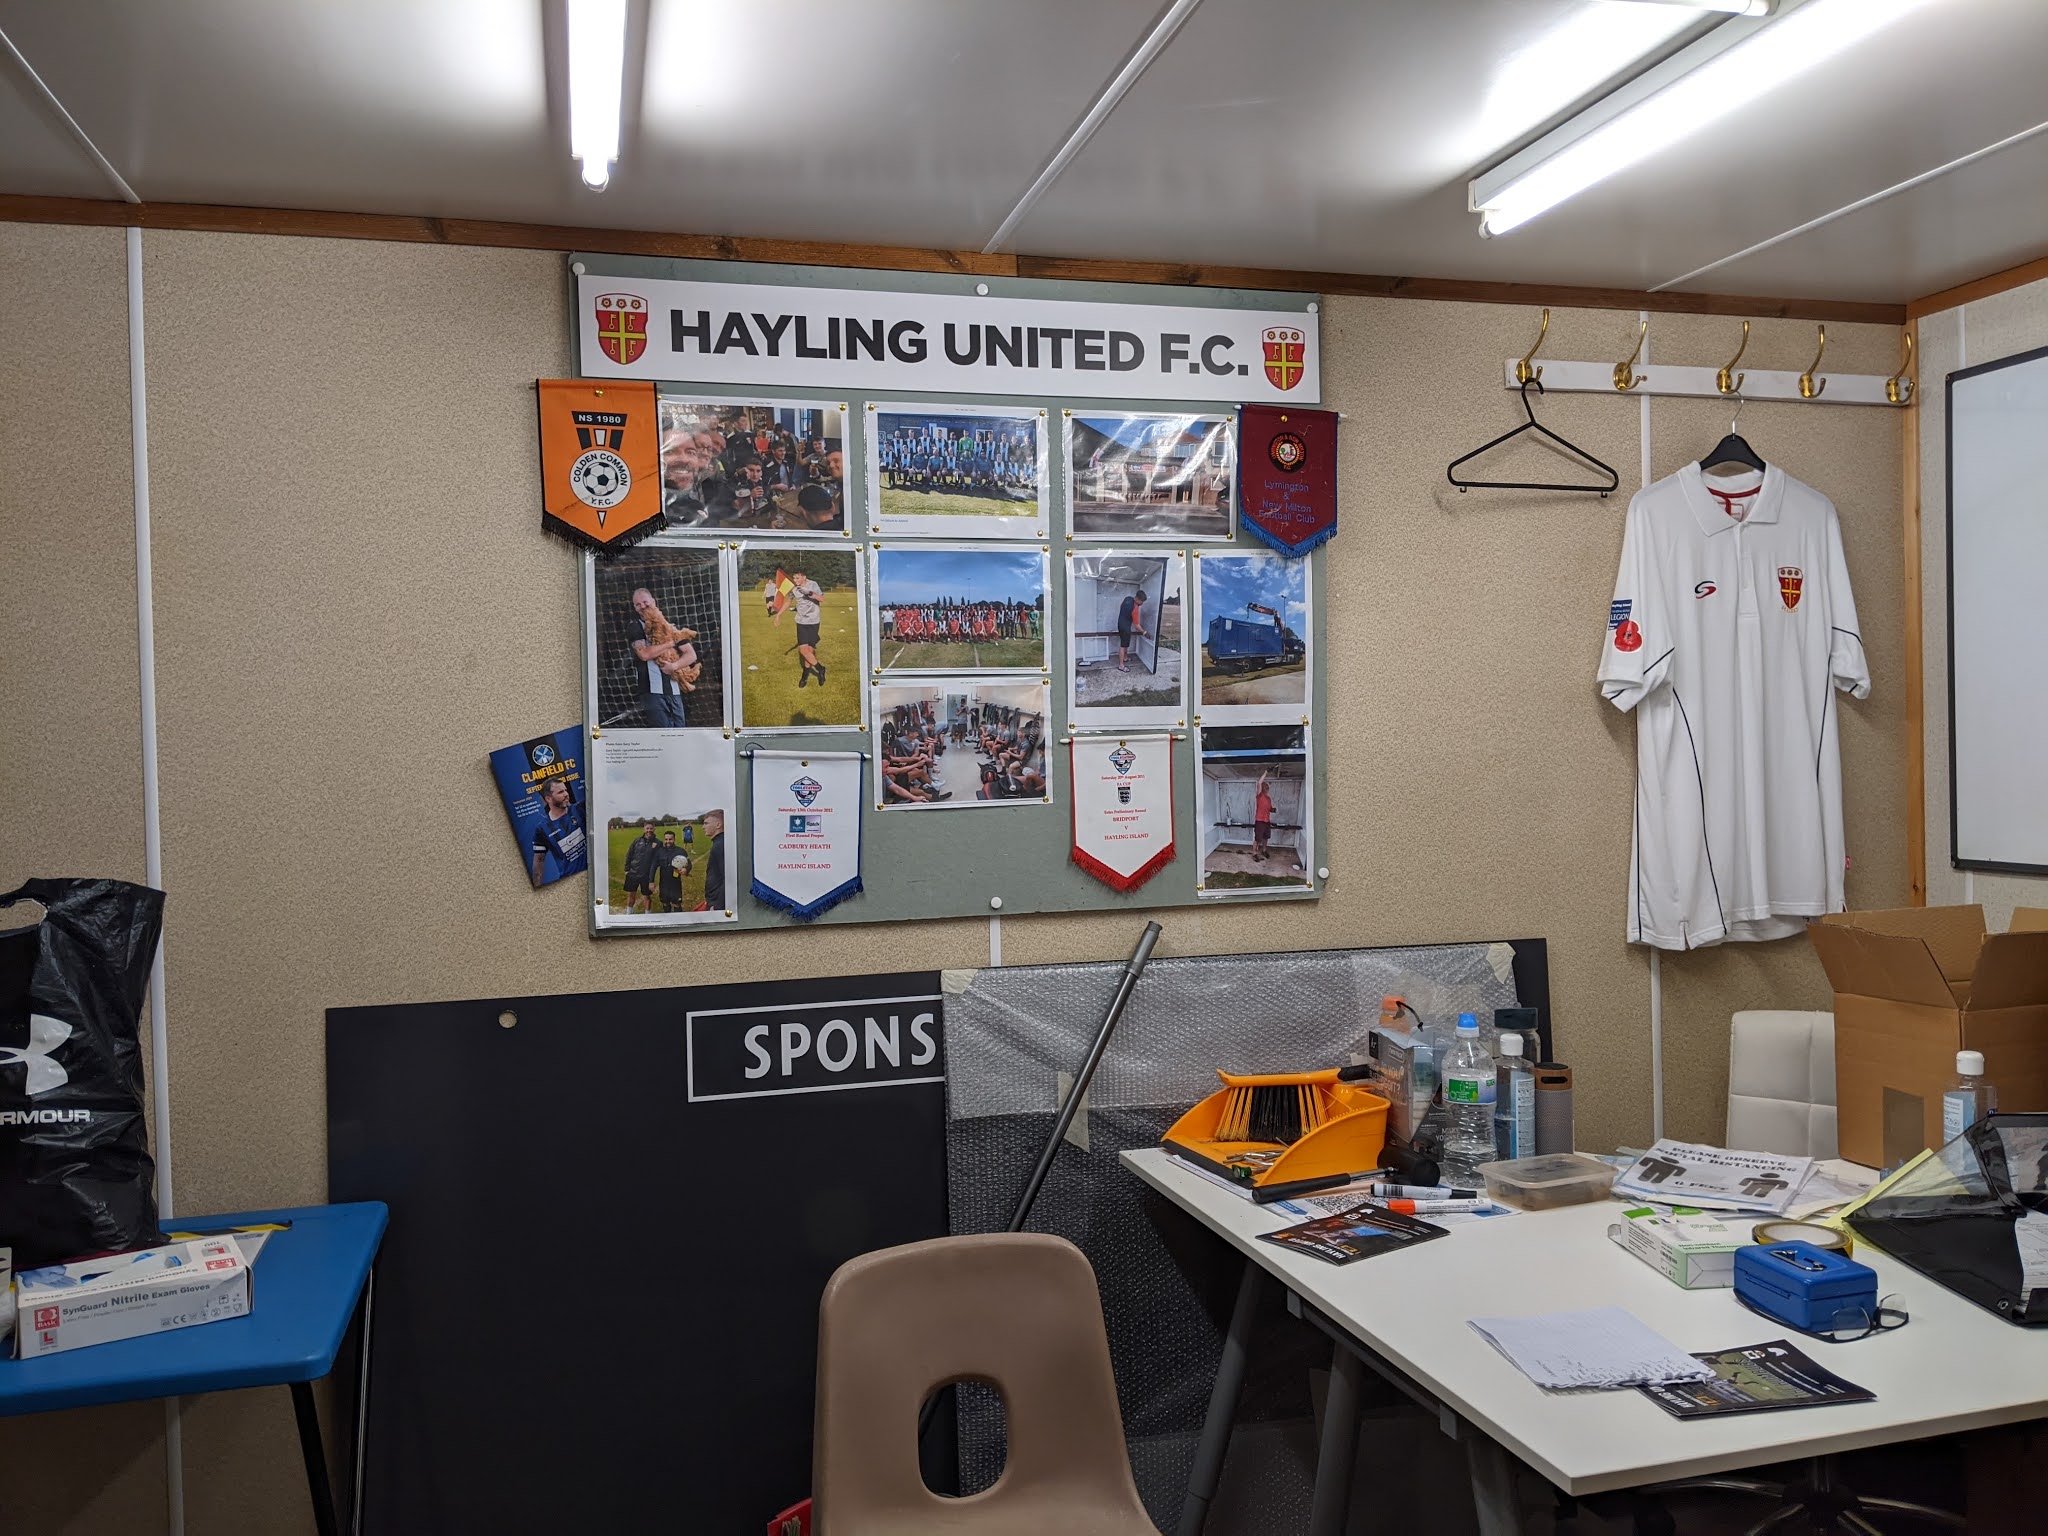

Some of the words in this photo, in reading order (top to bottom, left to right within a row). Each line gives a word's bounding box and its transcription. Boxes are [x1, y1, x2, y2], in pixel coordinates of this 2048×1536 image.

[670, 307, 928, 364] HAYLING
[944, 325, 1146, 373] UNITED
[1161, 333, 1249, 377] F.C.
[578, 414, 593, 422] NS
[597, 415, 621, 424] 1980
[573, 452, 598, 483] COLDEN
[599, 452, 628, 487] COMMON
[1264, 480, 1310, 493] Lymington
[1283, 492, 1290, 500] &
[1262, 499, 1281, 509] New
[1285, 502, 1312, 513] Milton
[1296, 512, 1316, 524] Club
[1610, 613, 1630, 621] LEGION
[521, 762, 565, 784] CLANFIELD
[565, 758, 576, 770] FC
[744, 1012, 937, 1079] SPONS
[1655, 1147, 1705, 1163] SOCIAL
[1709, 1158, 1798, 1172] DISTANCING
[1672, 1147, 1721, 1159] PLEASE
[1725, 1155, 1787, 1167] OBSERVE
[62, 1301, 108, 1316] SynGuard
[111, 1292, 150, 1307] Nitrile
[152, 1290, 178, 1299] Exam
[180, 1283, 211, 1294] Gloves
[43, 1331, 54, 1345] L
[1657, 1391, 1696, 1409] HAYLING
